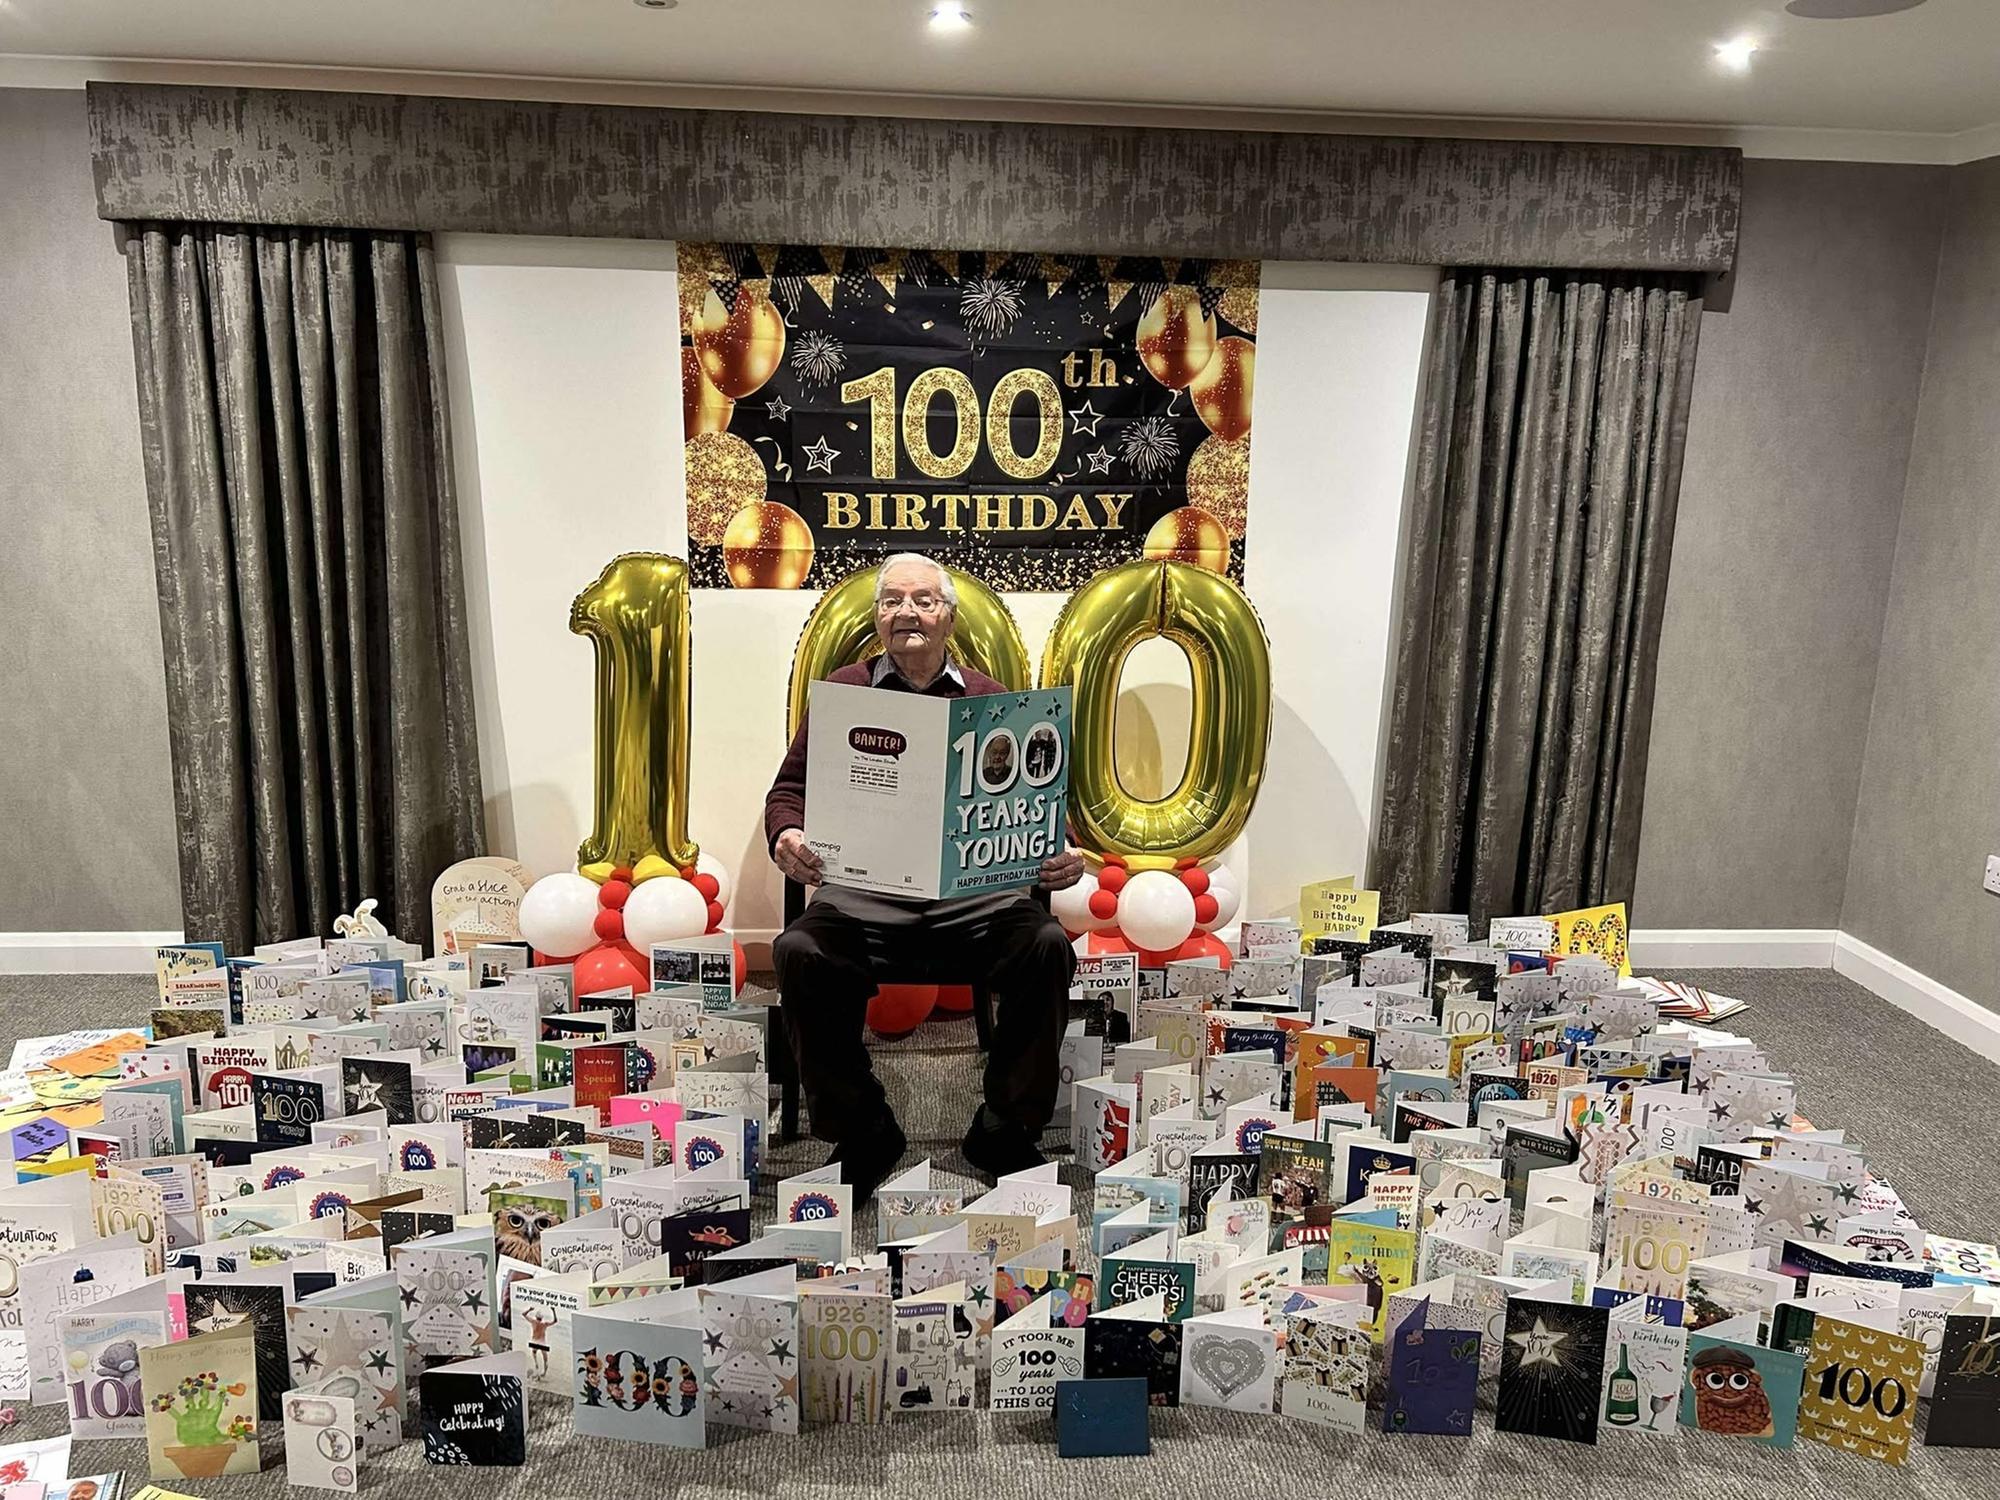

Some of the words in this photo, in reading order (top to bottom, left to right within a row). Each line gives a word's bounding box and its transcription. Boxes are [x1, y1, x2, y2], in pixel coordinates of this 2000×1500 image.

[841, 366, 1064, 479] 100
[1061, 349, 1119, 387] th
[823, 492, 1133, 531] BIRTHDAY
[854, 732, 901, 750] BANTER!
[952, 722, 1063, 797] 100
[956, 793, 1046, 833] YEARS
[954, 803, 1058, 868] YOUNG!
[810, 840, 842, 852] moonpig
[957, 875, 985, 888] HAPPY
[985, 870, 1025, 884] BIRTHDAY
[1025, 867, 1041, 878] HAR
[1321, 890, 1357, 904] Happy
[1331, 903, 1347, 911] 100
[1312, 910, 1365, 926] Birthday
[1323, 923, 1358, 932] HARRY
[254, 975, 278, 989] 100
[1088, 977, 1131, 988] TODAY
[213, 1047, 255, 1057] HAPPY
[202, 1056, 267, 1067] BIRTHDAY
[222, 1075, 247, 1084] HARRY
[583, 1074, 616, 1085] Special
[1530, 1072, 1558, 1085] 1926
[218, 1083, 252, 1106] 100
[447, 1094, 482, 1105] News
[577, 1091, 614, 1100] Birthd
[261, 1092, 318, 1127] 100
[1403, 1113, 1422, 1127] THIS
[1521, 1139, 1568, 1155] BIRTHDAY
[407, 1154, 427, 1166] 100
[694, 1150, 716, 1162] 100
[1294, 1155, 1324, 1169] YEAH
[488, 1166, 512, 1178] Happy
[1193, 1164, 1255, 1181] HAPPY
[1373, 1185, 1413, 1193] HAPPY
[1639, 1181, 1682, 1201] 1926
[102, 1189, 140, 1206] 1926
[205, 1208, 228, 1217] 100
[320, 1207, 345, 1217] 100
[801, 1206, 826, 1220] 100
[1022, 1201, 1045, 1215] 100
[1451, 1202, 1484, 1226] One
[97, 1206, 155, 1244] 100
[975, 1222, 1015, 1238] Birthday
[1859, 1227, 1879, 1236] Happy
[1879, 1228, 1905, 1238] Birthday
[1000, 1235, 1021, 1250] Boy
[626, 1245, 656, 1260] TODAY
[1622, 1235, 1690, 1274] 100
[1956, 1248, 1982, 1274] 100
[1117, 1271, 1179, 1285] CHEEKY
[545, 1291, 558, 1300] day
[1110, 1283, 1184, 1301] CHOPS!
[515, 1294, 545, 1305] anything
[560, 1302, 579, 1310] want.
[0, 1308, 23, 1327] TOD
[818, 1306, 866, 1322] 1926
[71, 1317, 95, 1328] HARRY
[807, 1324, 878, 1361] 100
[1002, 1337, 1016, 1350] IT
[1018, 1332, 1054, 1344] TOOK
[1055, 1335, 1075, 1349] ME
[1633, 1330, 1680, 1348] Birthday
[1018, 1350, 1057, 1366] 100
[577, 1347, 699, 1417] 100
[1018, 1368, 1056, 1385] years
[1030, 1385, 1055, 1395] LOO
[1814, 1362, 1907, 1418] 100
[994, 1398, 1031, 1409] THIS
[1035, 1397, 1055, 1408] GO
[439, 1415, 505, 1433] Celebrating!
